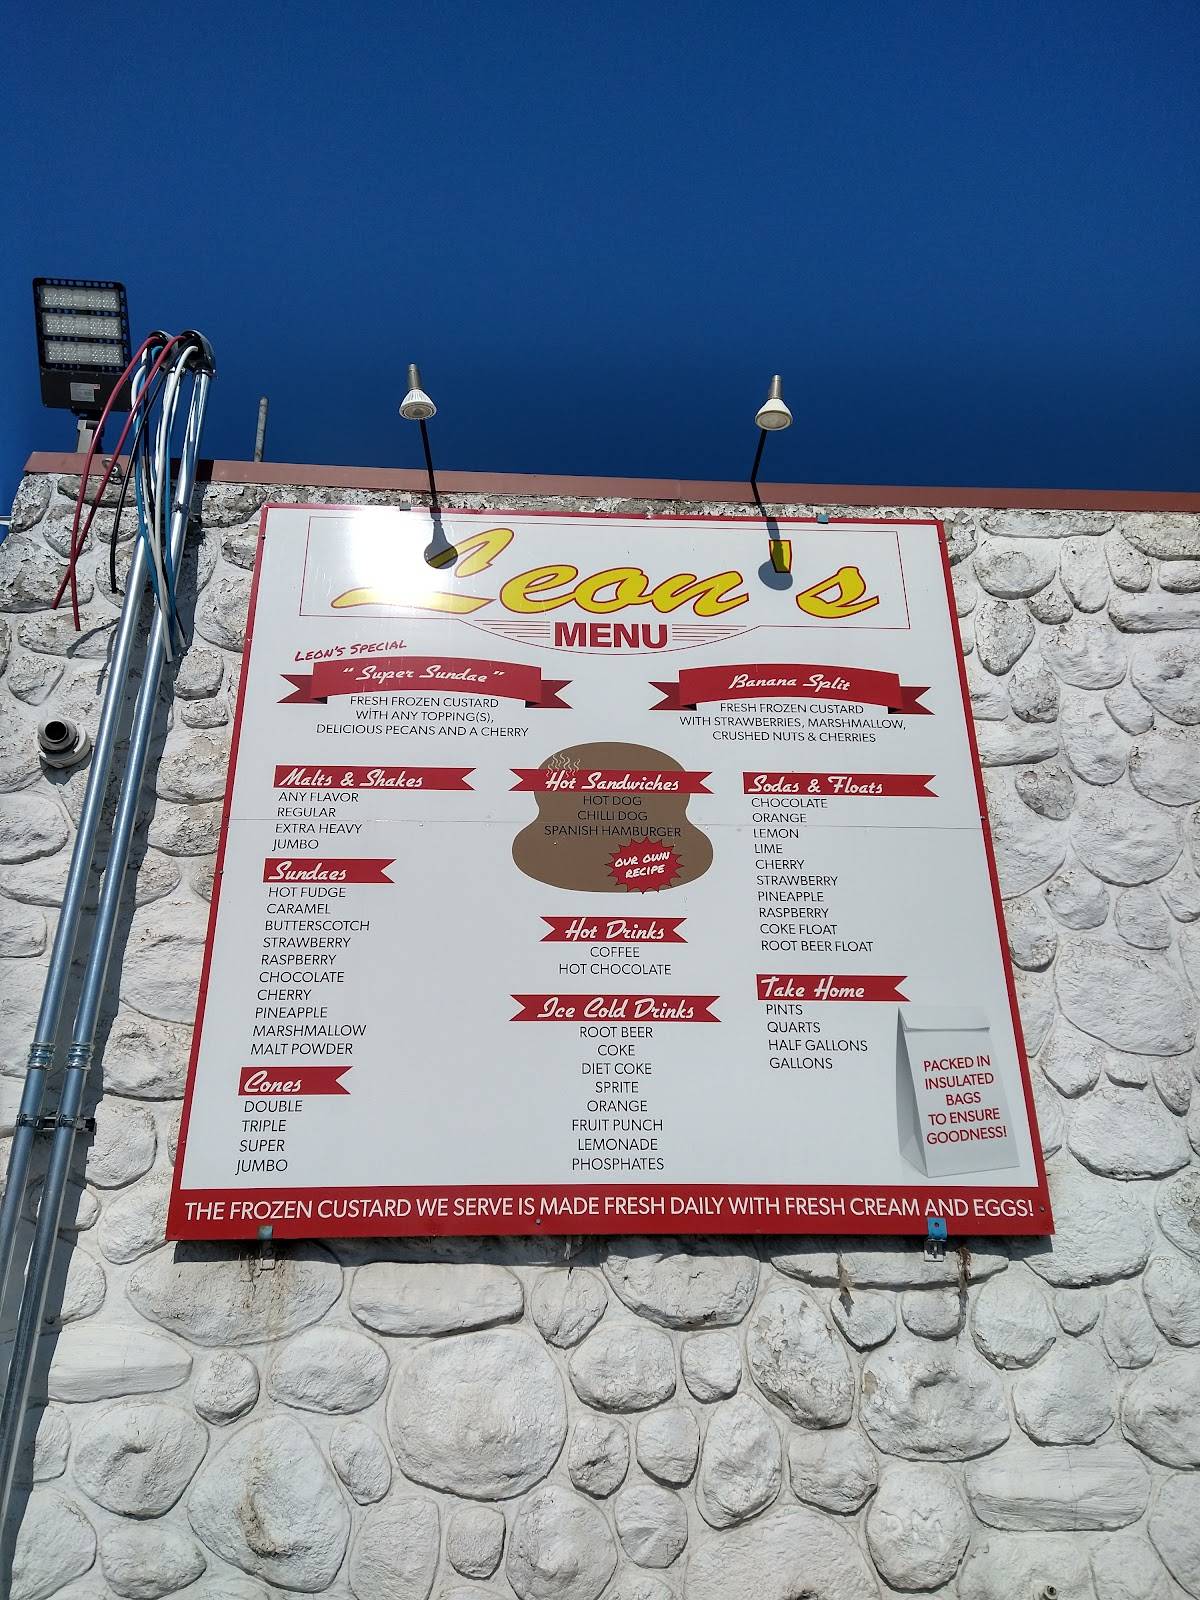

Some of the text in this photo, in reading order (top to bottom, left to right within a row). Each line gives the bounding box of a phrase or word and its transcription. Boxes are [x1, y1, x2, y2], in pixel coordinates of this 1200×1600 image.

[331, 528, 879, 618] Leon's
[554, 621, 668, 649] MENU
[350, 640, 407, 655] SPECIAL
[728, 674, 851, 693] Banana Split
[350, 695, 499, 708] FRESH FROZEN CUSTARD
[720, 703, 864, 715] FRESH FROZEN CUSTARD
[355, 710, 494, 723] WITH ANY TOPPING(S),
[679, 716, 907, 731] WITH STRAWBERRIES, MARSHMALLOW,
[316, 723, 529, 738] DELICIOUS PECANS AND A CHERRY
[712, 731, 876, 743] CRUSHED NUTS & CHERRIES
[278, 767, 423, 789] Malts & Shakes
[545, 771, 680, 792] Hot Sandwiches
[747, 775, 884, 795] Sodas & Floats
[278, 792, 359, 803] ANY FLAVOR
[583, 795, 642, 806] HOT DOG
[751, 798, 828, 809] CHOCOLATE
[277, 807, 336, 818] REGULAR
[577, 810, 648, 821] CHILLI DOG
[752, 813, 807, 823] ORANGE
[275, 823, 362, 834] EXTRA HEAVY
[544, 825, 681, 837] SPANISH HAMBURGER
[753, 828, 799, 839] LEMON
[272, 839, 319, 852] JUMBO
[754, 843, 783, 854] LIME
[614, 851, 671, 868] OUR OWN
[755, 859, 805, 870] CHERRY
[268, 861, 347, 881] Sundaes
[625, 864, 666, 879] RECIPE
[756, 875, 838, 886] STRAWBERRY
[268, 887, 347, 898] HOT FUDGE
[757, 891, 824, 902] PINEAPPLE
[266, 903, 331, 915] CARAMEL
[759, 907, 829, 918] RASPBERRY
[264, 920, 370, 932] BUTTERSCOTCH
[564, 917, 665, 941] Hot Drinks
[760, 923, 838, 935] COKE FLOAT
[262, 937, 351, 949] STRAWBERRY
[761, 940, 874, 952] ROOT BEER FLOAT
[589, 946, 640, 958] COFFEE
[260, 954, 337, 966] RASPBERRY
[559, 963, 672, 976] HOT CHOCOLATE
[258, 971, 345, 984] CHOCOLATE
[760, 976, 865, 1000] Take Home
[257, 989, 312, 1001] CHERRY
[255, 1007, 328, 1019] PINEAPPLE
[536, 996, 695, 1019] Ice Cold Drinks
[766, 1004, 803, 1015] PINTS
[252, 1024, 367, 1037] MARSHMALLOW
[579, 1026, 653, 1038] ROOT BEER
[767, 1021, 821, 1034] QUARTS
[250, 1043, 353, 1055] MALT POWDER
[597, 1044, 635, 1056] COKE
[768, 1039, 868, 1052] HALF GALLONS
[581, 1062, 652, 1075] DIET COKE
[769, 1057, 833, 1070] GALLONS
[923, 1055, 991, 1072] PACKED IN
[243, 1070, 302, 1093] Cones
[595, 1081, 639, 1094] SPRITE
[924, 1072, 994, 1090] INSULATED
[945, 1091, 981, 1106] BAGS
[243, 1100, 303, 1113] DOUBLE
[586, 1100, 648, 1112] ORANGE
[928, 1108, 1001, 1126] TO ENSURE
[242, 1119, 287, 1133] TRIPLE
[572, 1119, 663, 1131] FRUIT PUNCH
[926, 1126, 1008, 1145] GOODNESS!
[239, 1139, 285, 1152] SUPER
[577, 1138, 658, 1151] LEMONADE
[235, 1159, 288, 1176] JUMBO
[572, 1157, 665, 1170] PHOSPHATES
[184, 1196, 1035, 1221] THE FROZEN CUSTARD WE SERVE IS MADE FRESH DAILY WITH FRESH CREAM AND EGGS!
